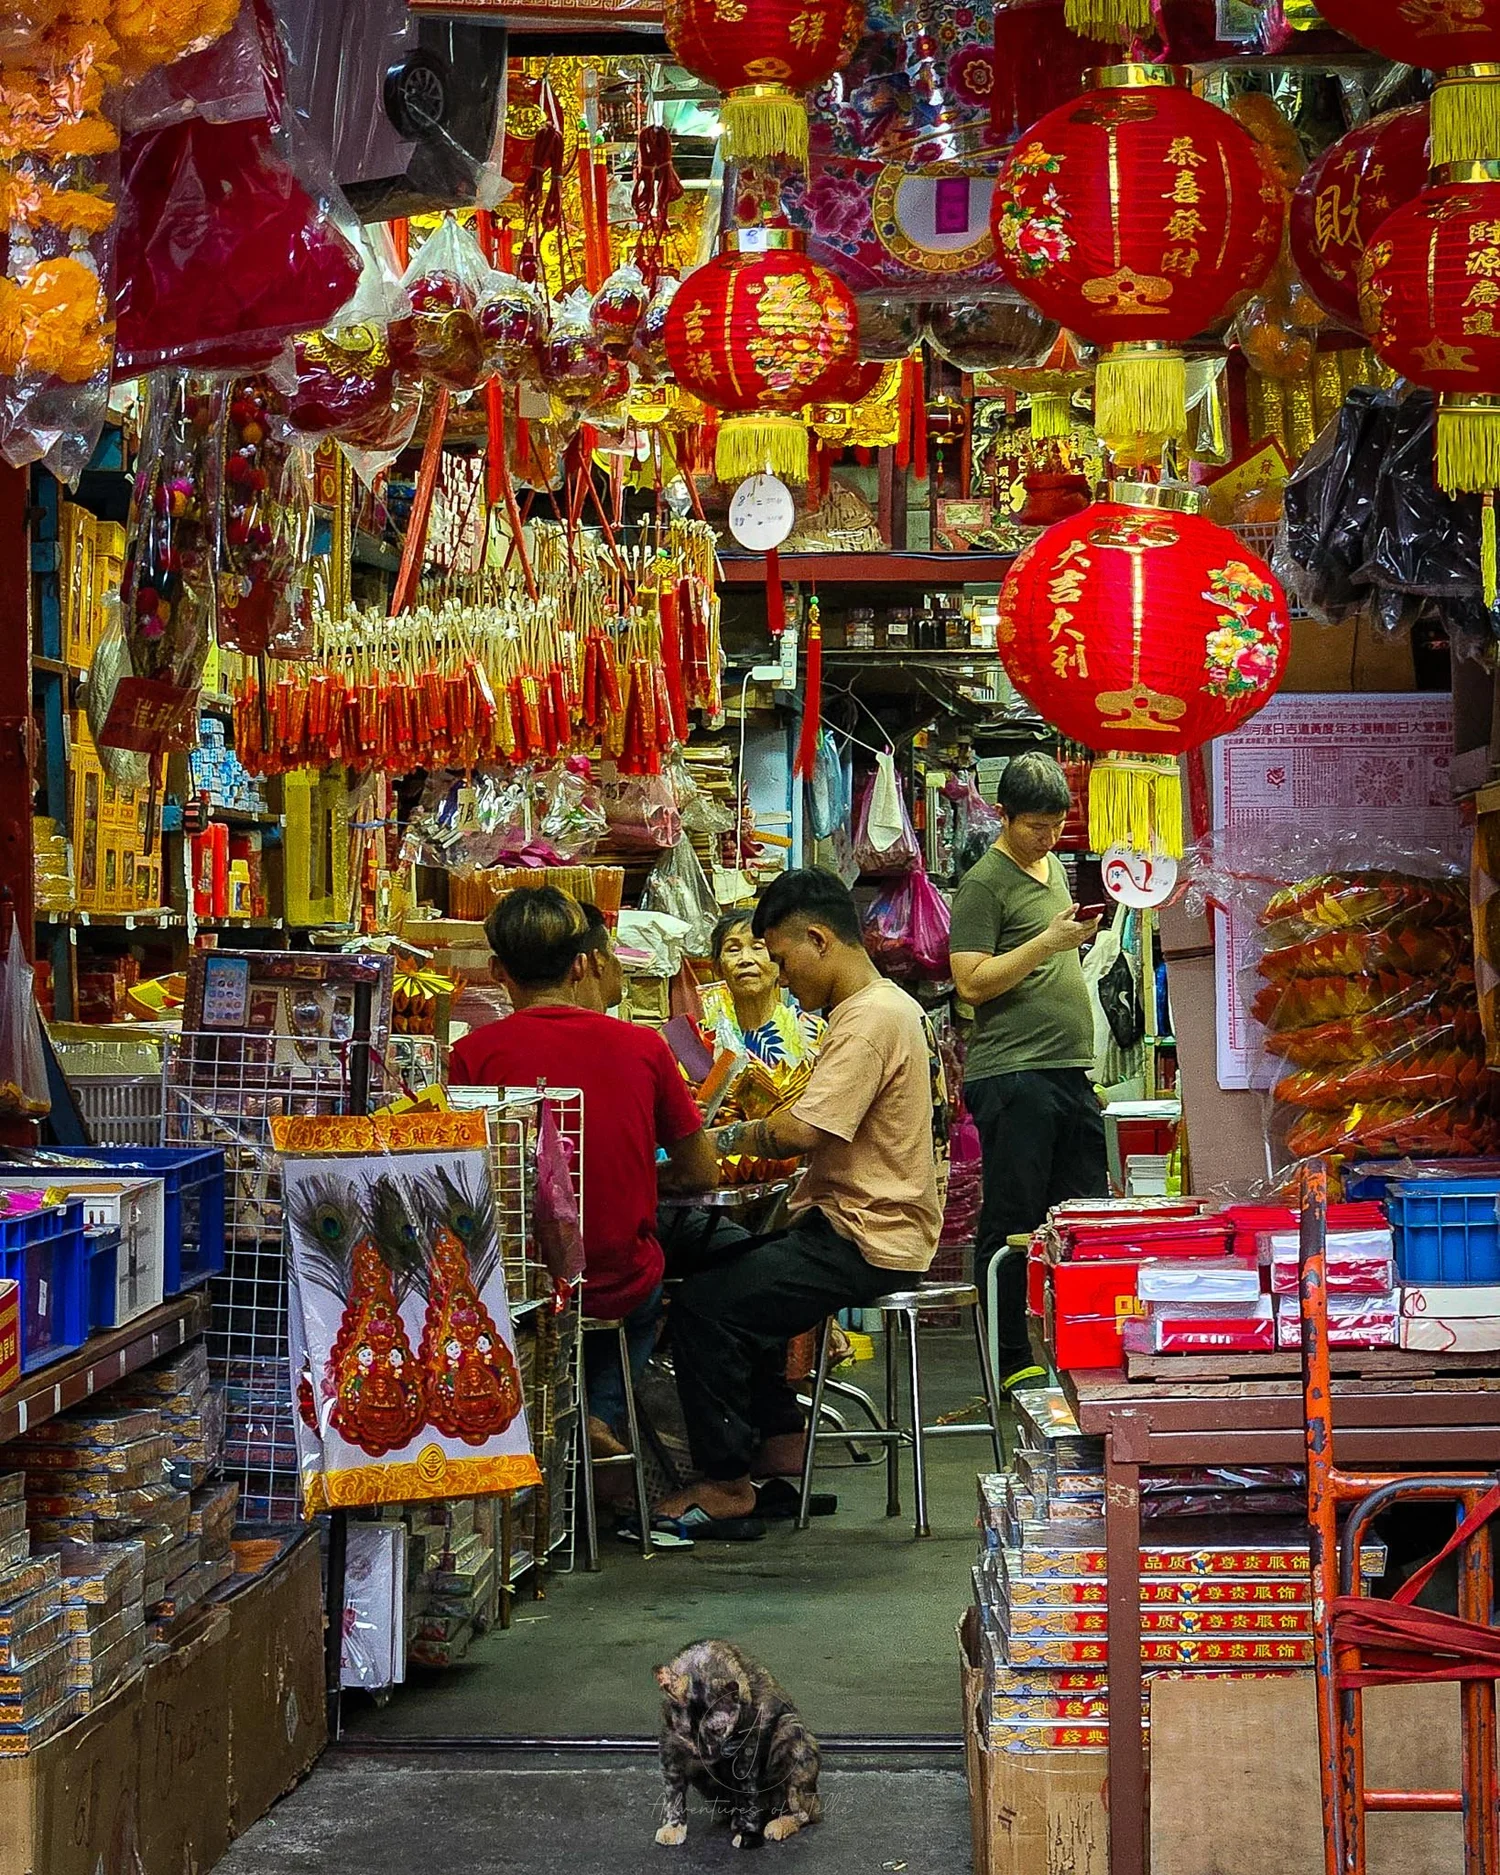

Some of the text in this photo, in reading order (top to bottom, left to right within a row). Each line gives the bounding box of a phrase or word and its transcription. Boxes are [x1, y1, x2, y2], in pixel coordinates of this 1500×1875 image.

[1161, 136, 1207, 278] 恭喜發財
[1047, 540, 1092, 678] 大吉大利
[1219, 1553, 1310, 1569] 尊贵服饰
[1205, 1586, 1296, 1601] 尊贵服饰
[1208, 1614, 1298, 1629] 尊贵服饰
[1205, 1643, 1296, 1658] 尊贵服饰
[1062, 1729, 1107, 1744] 经典
